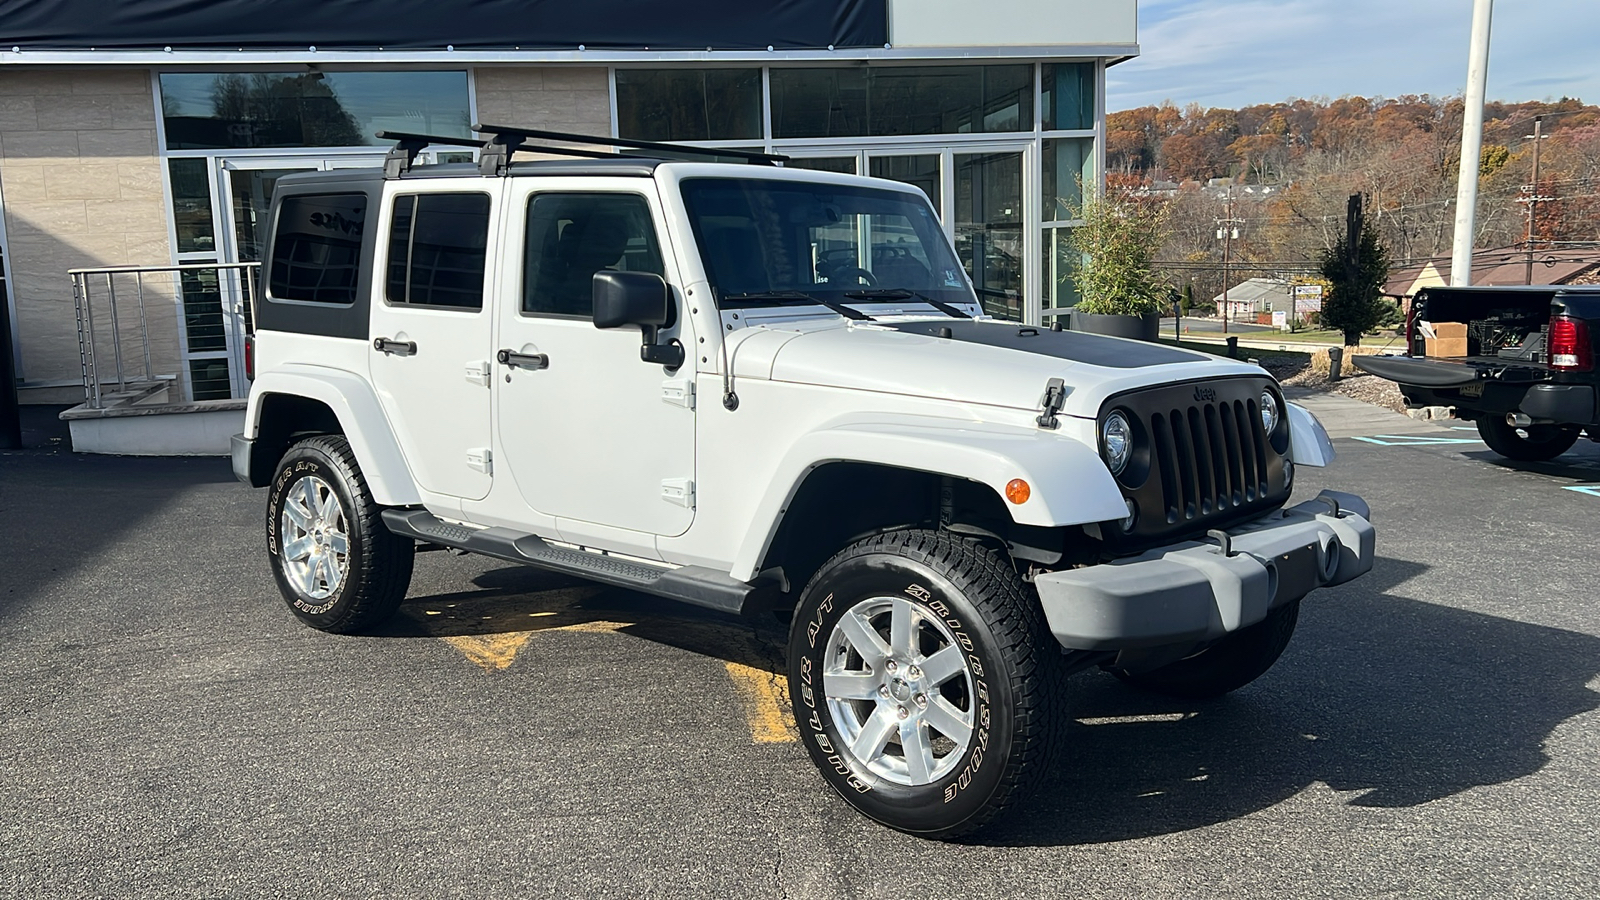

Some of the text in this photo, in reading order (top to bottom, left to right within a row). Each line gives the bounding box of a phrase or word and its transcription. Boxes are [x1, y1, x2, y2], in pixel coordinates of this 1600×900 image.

[1193, 386, 1217, 402] Jeep
[269, 466, 292, 555] DUELER
[800, 592, 873, 794] DUELER A/T
[903, 583, 990, 804] BRIDGESTONE
